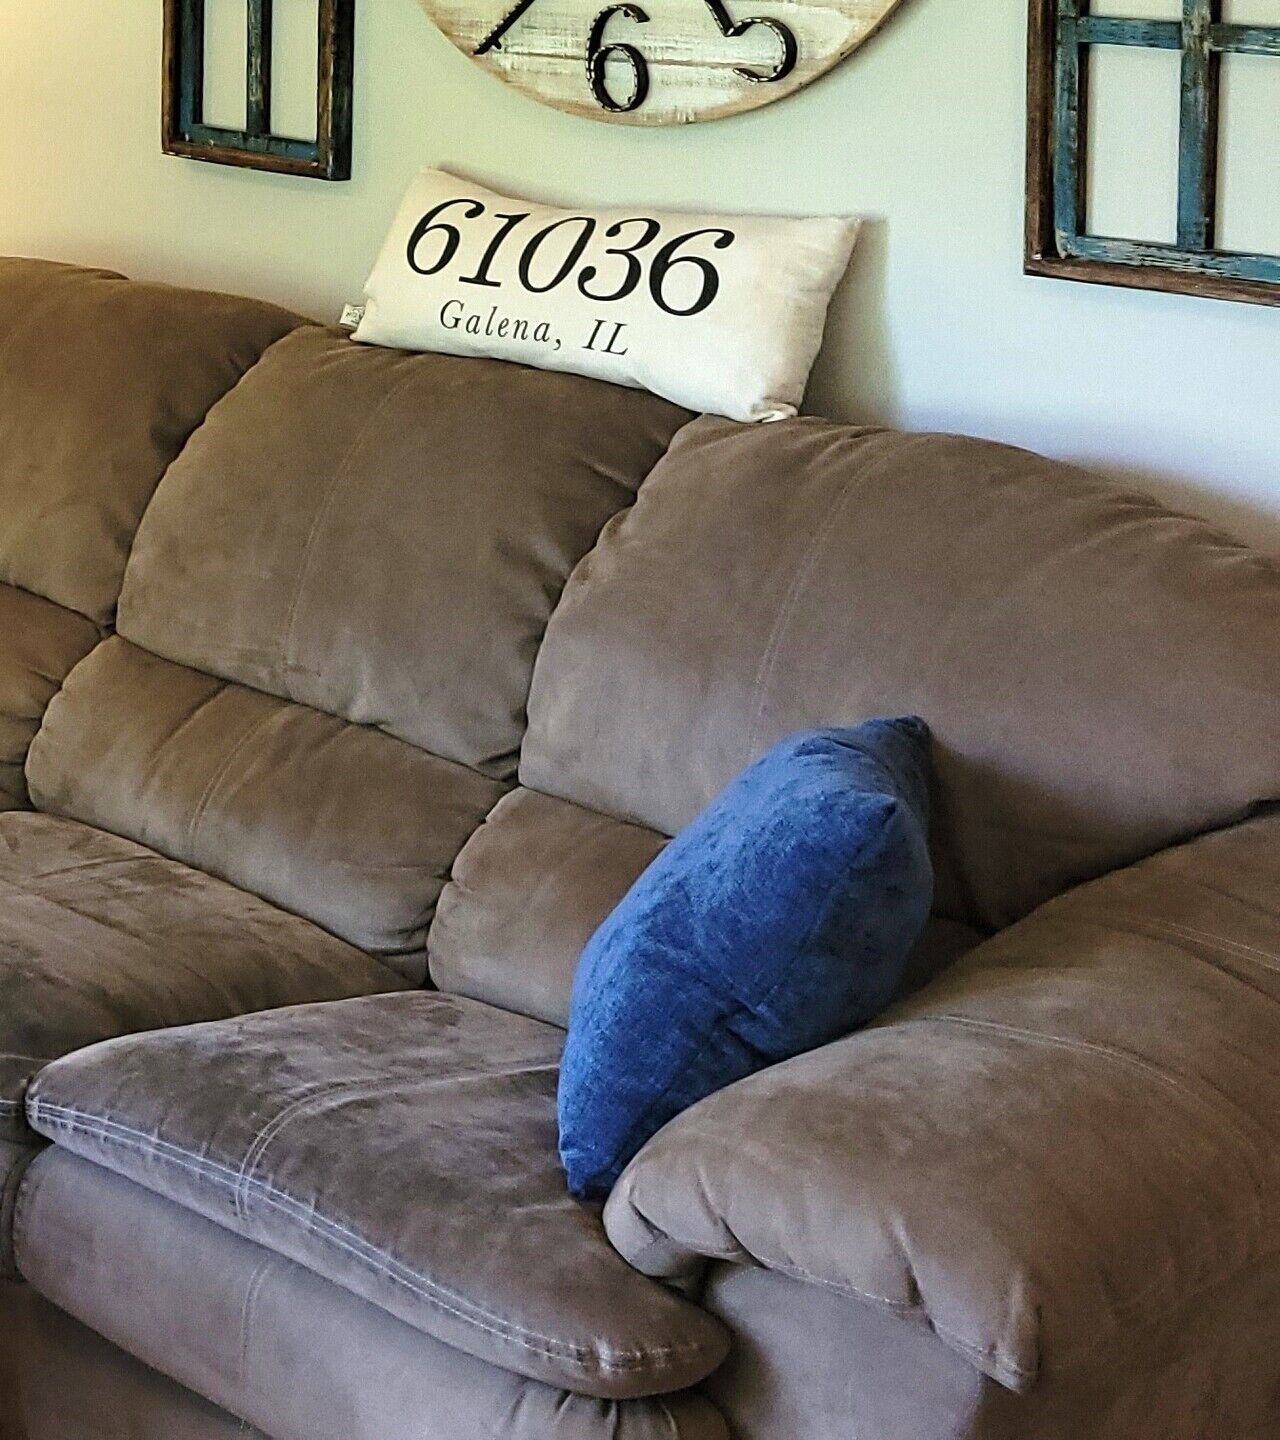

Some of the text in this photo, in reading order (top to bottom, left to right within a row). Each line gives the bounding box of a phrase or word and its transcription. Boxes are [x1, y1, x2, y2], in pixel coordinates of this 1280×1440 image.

[585, 2, 649, 113] 6
[405, 198, 735, 317] 61036
[439, 299, 630, 357] Galena, IL
